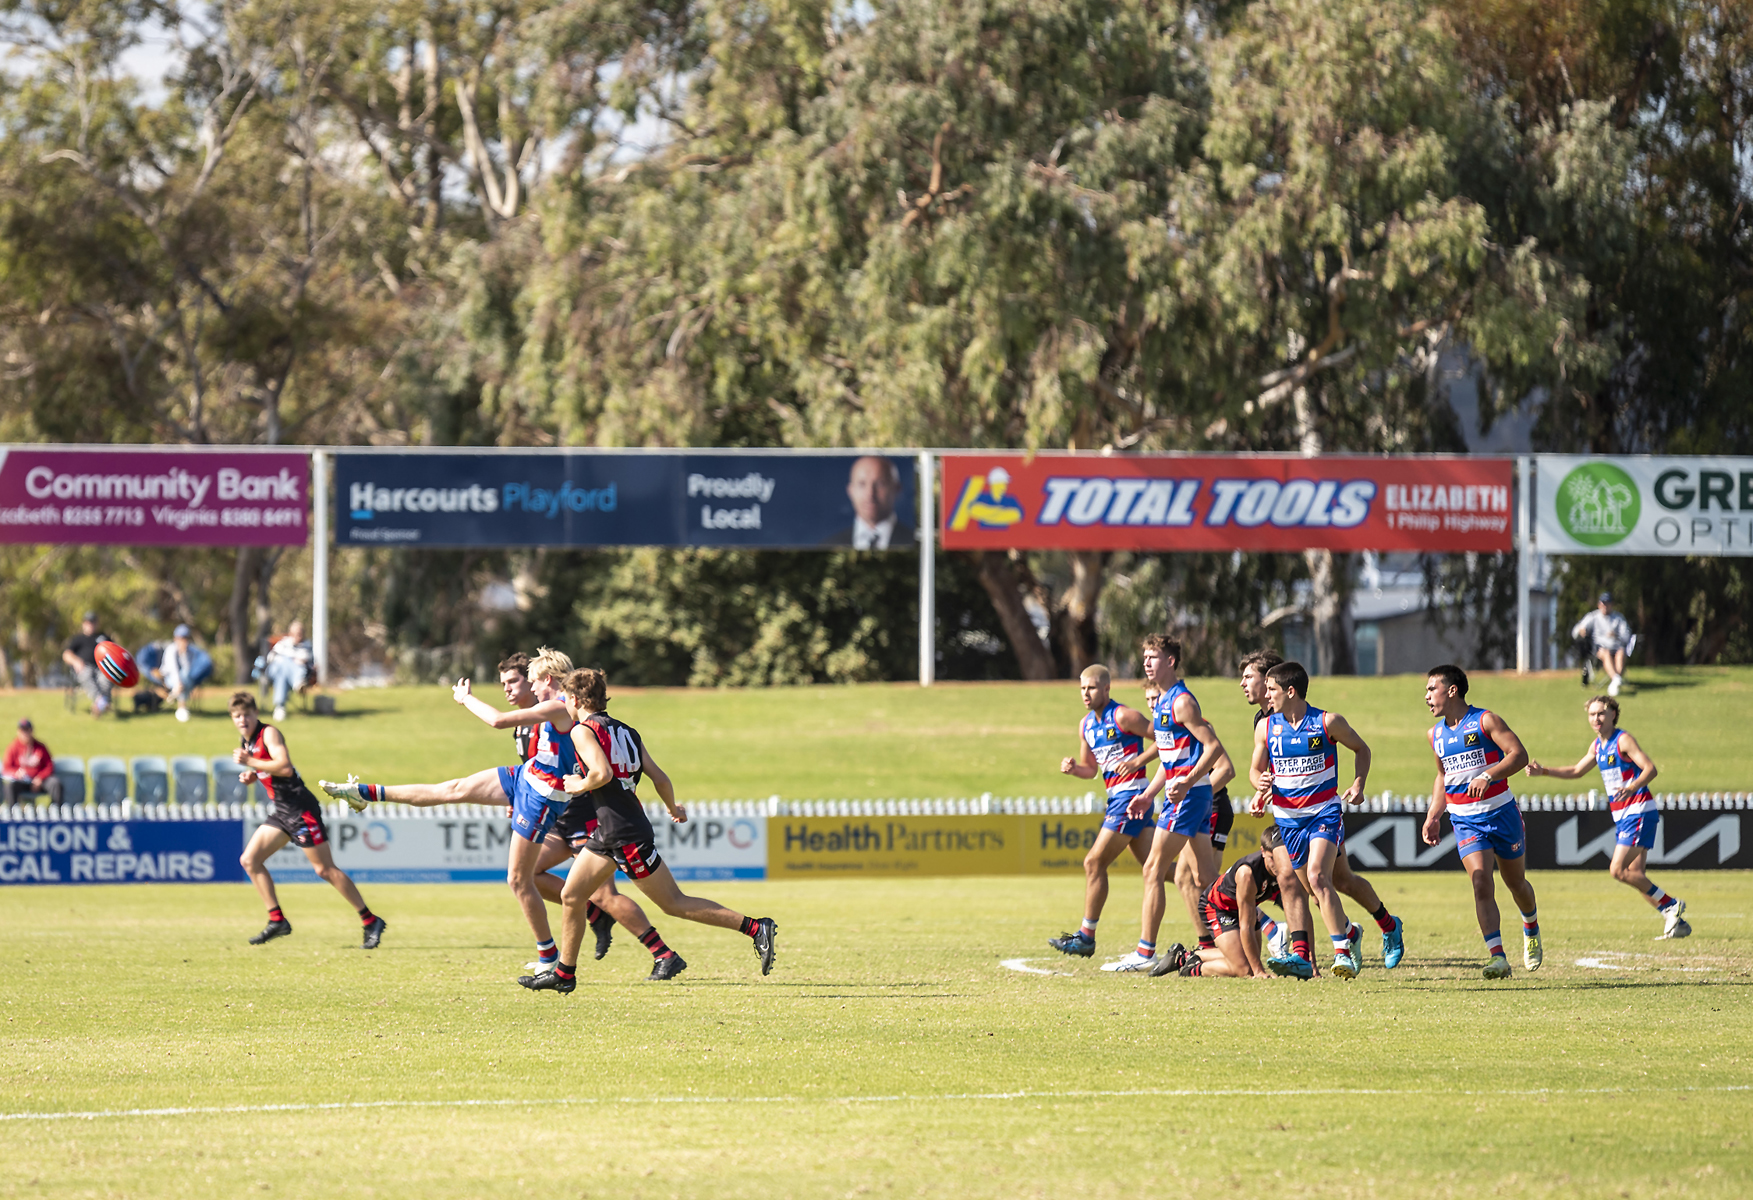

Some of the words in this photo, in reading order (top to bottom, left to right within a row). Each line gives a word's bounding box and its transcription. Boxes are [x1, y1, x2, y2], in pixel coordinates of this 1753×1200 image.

[25, 466, 211, 508] Community
[217, 467, 299, 501] Bank
[350, 482, 498, 513] Harcourts
[503, 480, 617, 520] Playford
[688, 473, 776, 503] Proudly
[1385, 484, 1507, 512] ELIZABETH
[701, 503, 762, 530] Local
[1037, 477, 1202, 526] TOTAL
[1206, 478, 1377, 528] TOOLS
[151, 504, 219, 531] Virginia
[1387, 514, 1395, 529] 1
[1398, 514, 1440, 533] Philip
[1444, 515, 1507, 533] Highway
[608, 726, 641, 773] 40
[1269, 737, 1283, 756] 21
[1302, 755, 1324, 765] PAGE
[1460, 750, 1483, 762] PAGE
[1450, 758, 1485, 772] HYUNDAI
[107, 824, 132, 852] &
[785, 822, 880, 851] Health
[886, 822, 1004, 851] Partners
[70, 852, 215, 880] REPAIRS
